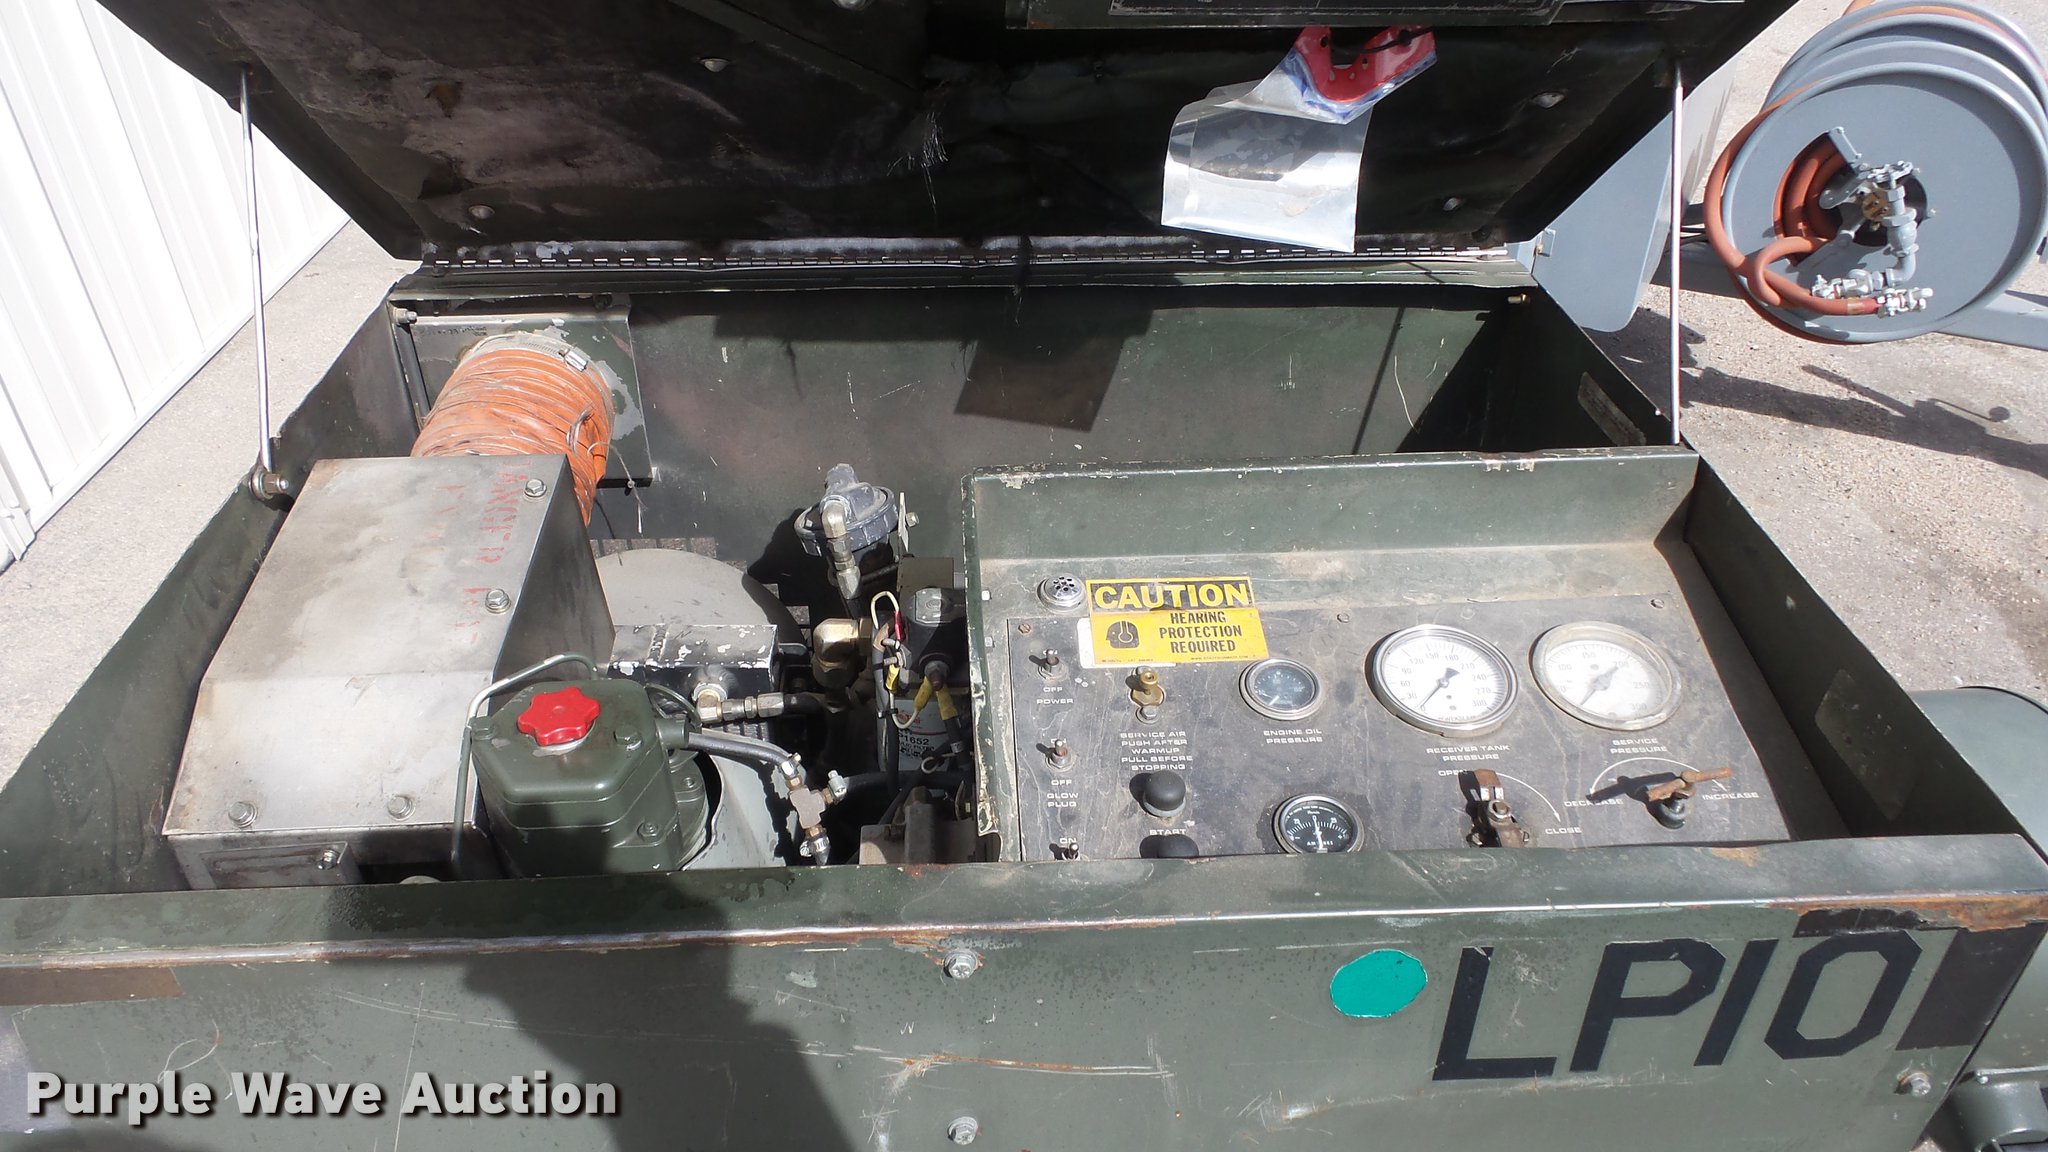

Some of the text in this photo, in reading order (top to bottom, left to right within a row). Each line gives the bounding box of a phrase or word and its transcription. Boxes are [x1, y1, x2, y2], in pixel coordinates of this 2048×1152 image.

[1094, 583, 1250, 609] CAUTION
[1170, 611, 1226, 624] HEARING
[1159, 625, 1242, 639] PROTECTION
[1170, 640, 1236, 653] REQUIRED
[1266, 736, 1323, 744] PRESSURE
[1612, 737, 1659, 745] SERVICE
[1426, 746, 1478, 754] RECEIVER
[1610, 745, 1668, 754] PRESSURE
[1442, 753, 1500, 762] PRESSURE
[1702, 791, 1760, 800] INCREASE
[1564, 798, 1624, 807] DECRASE
